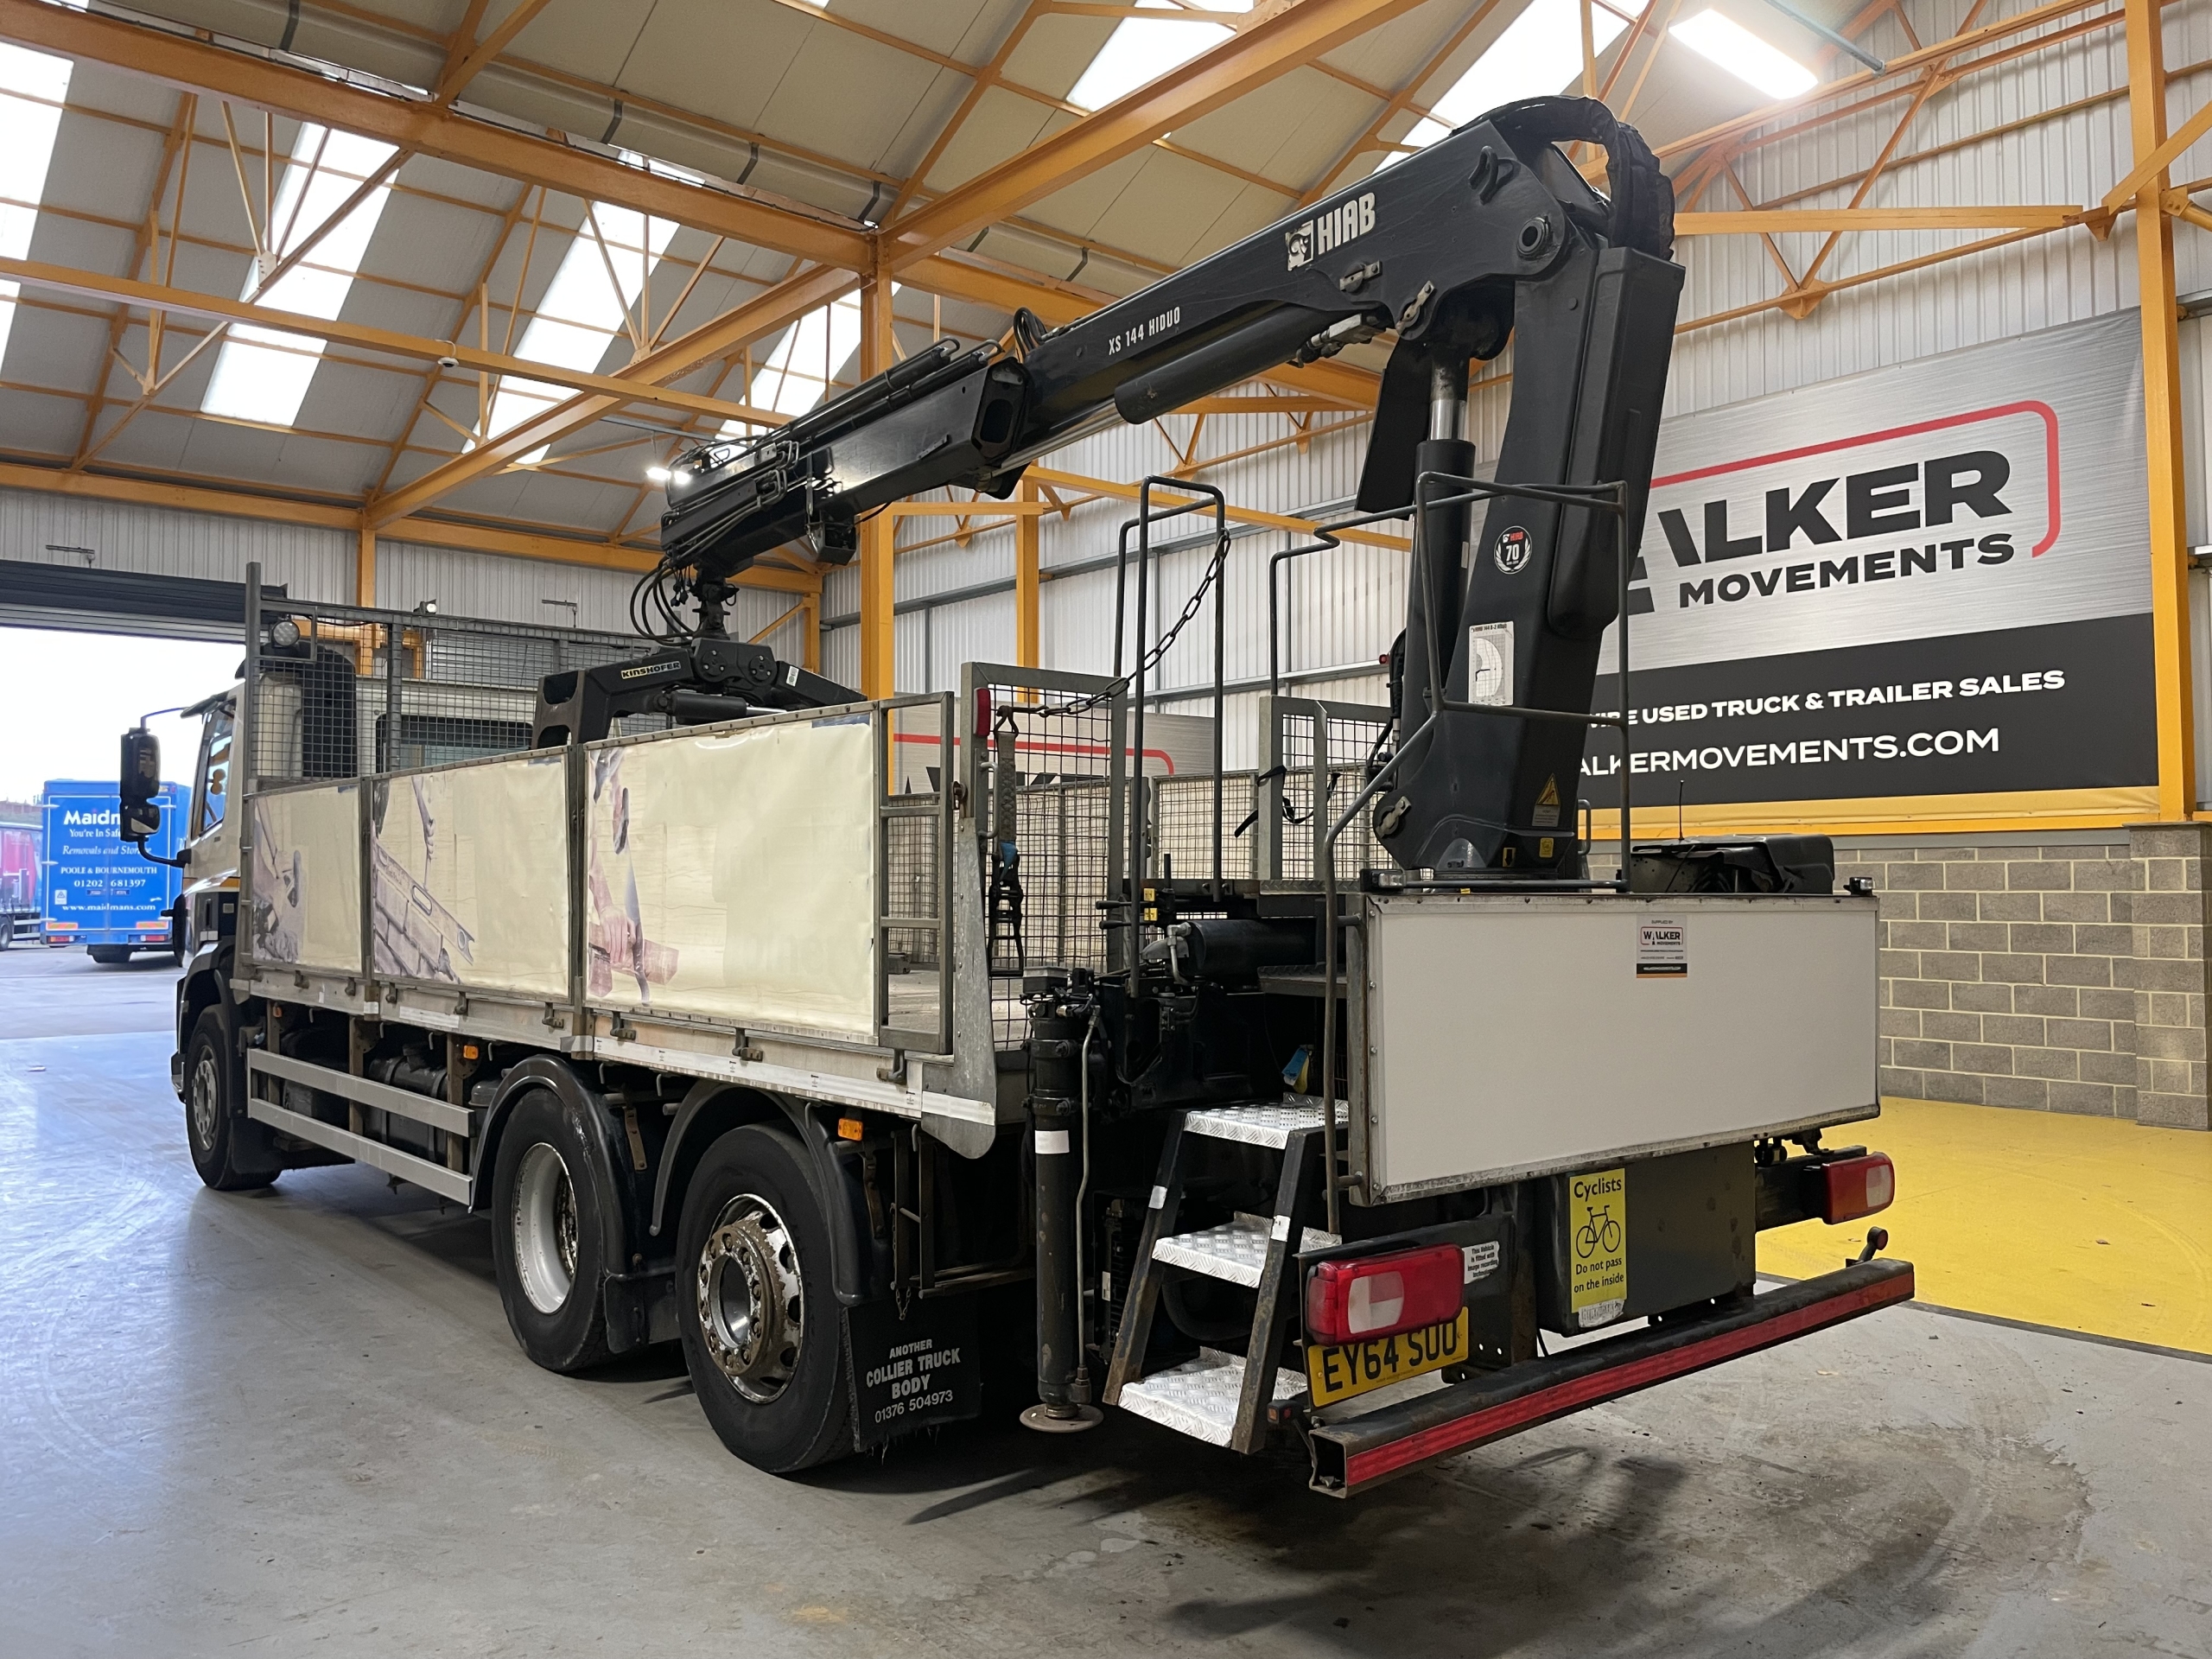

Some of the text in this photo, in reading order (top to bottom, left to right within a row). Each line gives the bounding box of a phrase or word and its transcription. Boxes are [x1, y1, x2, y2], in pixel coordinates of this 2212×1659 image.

[1318, 193, 1376, 255] HIAB
[1109, 306, 1180, 356] XS 144 HIDUO
[1654, 450, 2013, 568] ALKER
[1505, 543, 1520, 562] 70
[1680, 533, 2015, 609] MOVEMENTS
[622, 662, 680, 678] KINSHOFER
[1642, 703, 1708, 724] USED
[1711, 695, 1801, 718] TRUCK
[1804, 692, 1825, 710] &
[1827, 680, 1954, 709] TRAILER
[1959, 670, 2066, 697] SALES
[1580, 728, 1999, 776] ALKERMOVEMENTS.COM
[70, 829, 94, 837] You're
[96, 829, 104, 837] In
[62, 845, 101, 855] Removals
[103, 845, 119, 855] and
[1643, 931, 1681, 940] WALKER
[1573, 1178, 1622, 1202] Cyclists
[1576, 1257, 1622, 1275] Do not pass
[1573, 1273, 1624, 1293] on the inside
[889, 1338, 933, 1359] ANOTHER
[866, 1348, 961, 1388] COLLIER TRUCK
[1323, 1335, 1400, 1393] EY64
[892, 1374, 931, 1400] BODY
[874, 1389, 954, 1423] 01376 504973
